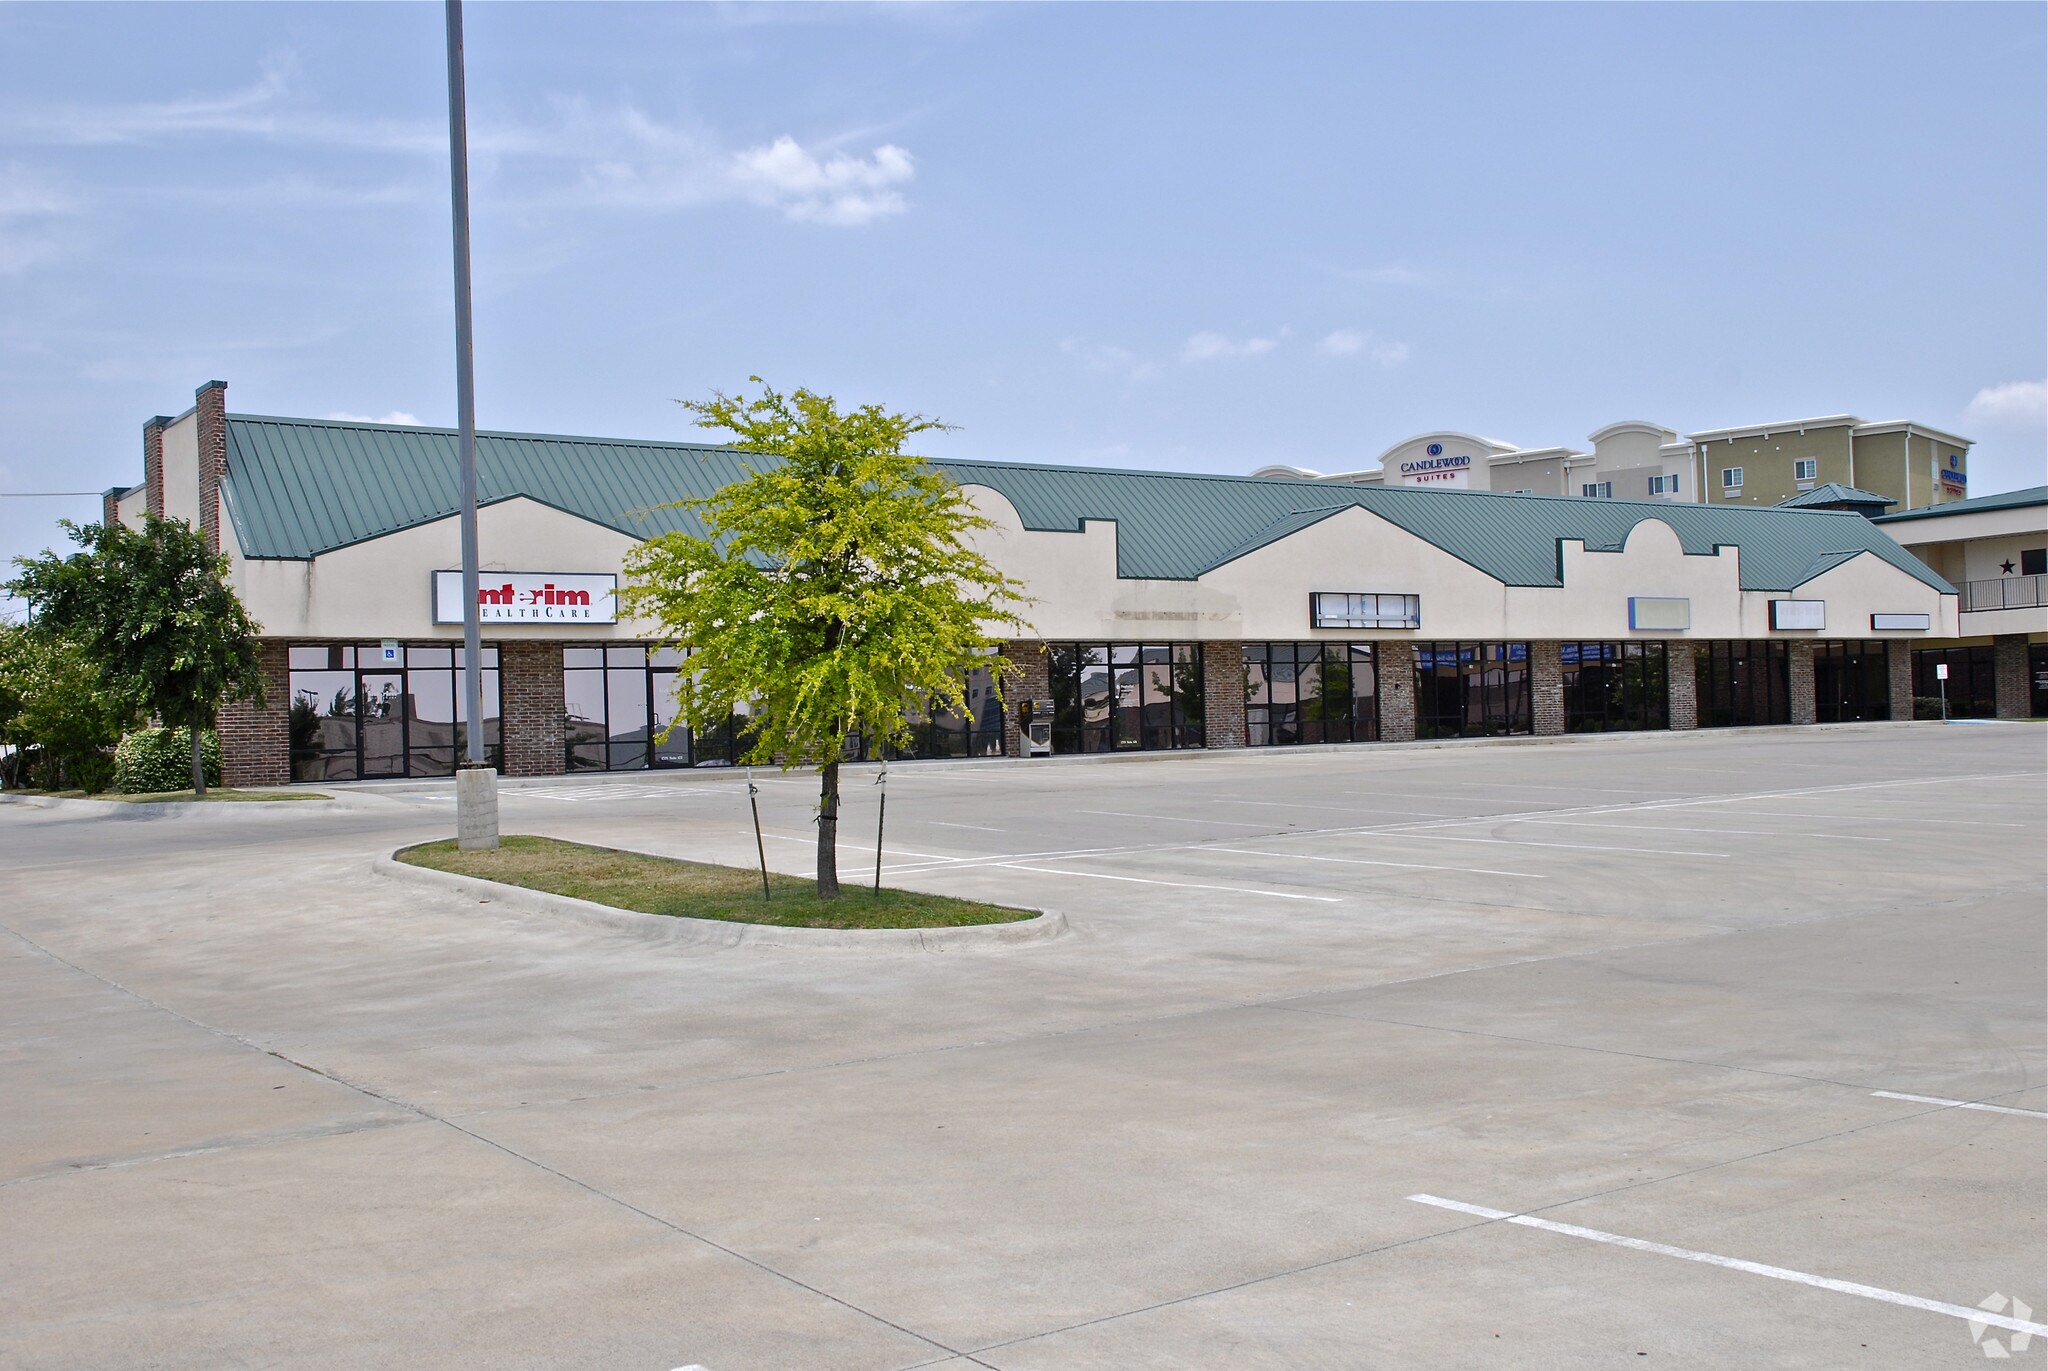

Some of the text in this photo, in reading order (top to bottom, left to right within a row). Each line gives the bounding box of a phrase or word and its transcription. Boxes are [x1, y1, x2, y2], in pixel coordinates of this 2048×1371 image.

[1401, 455, 1470, 472] CANDLEWOOD
[1416, 473, 1455, 482] SUITES
[478, 583, 590, 606] nterim
[482, 606, 590, 618] EALTHCARE
